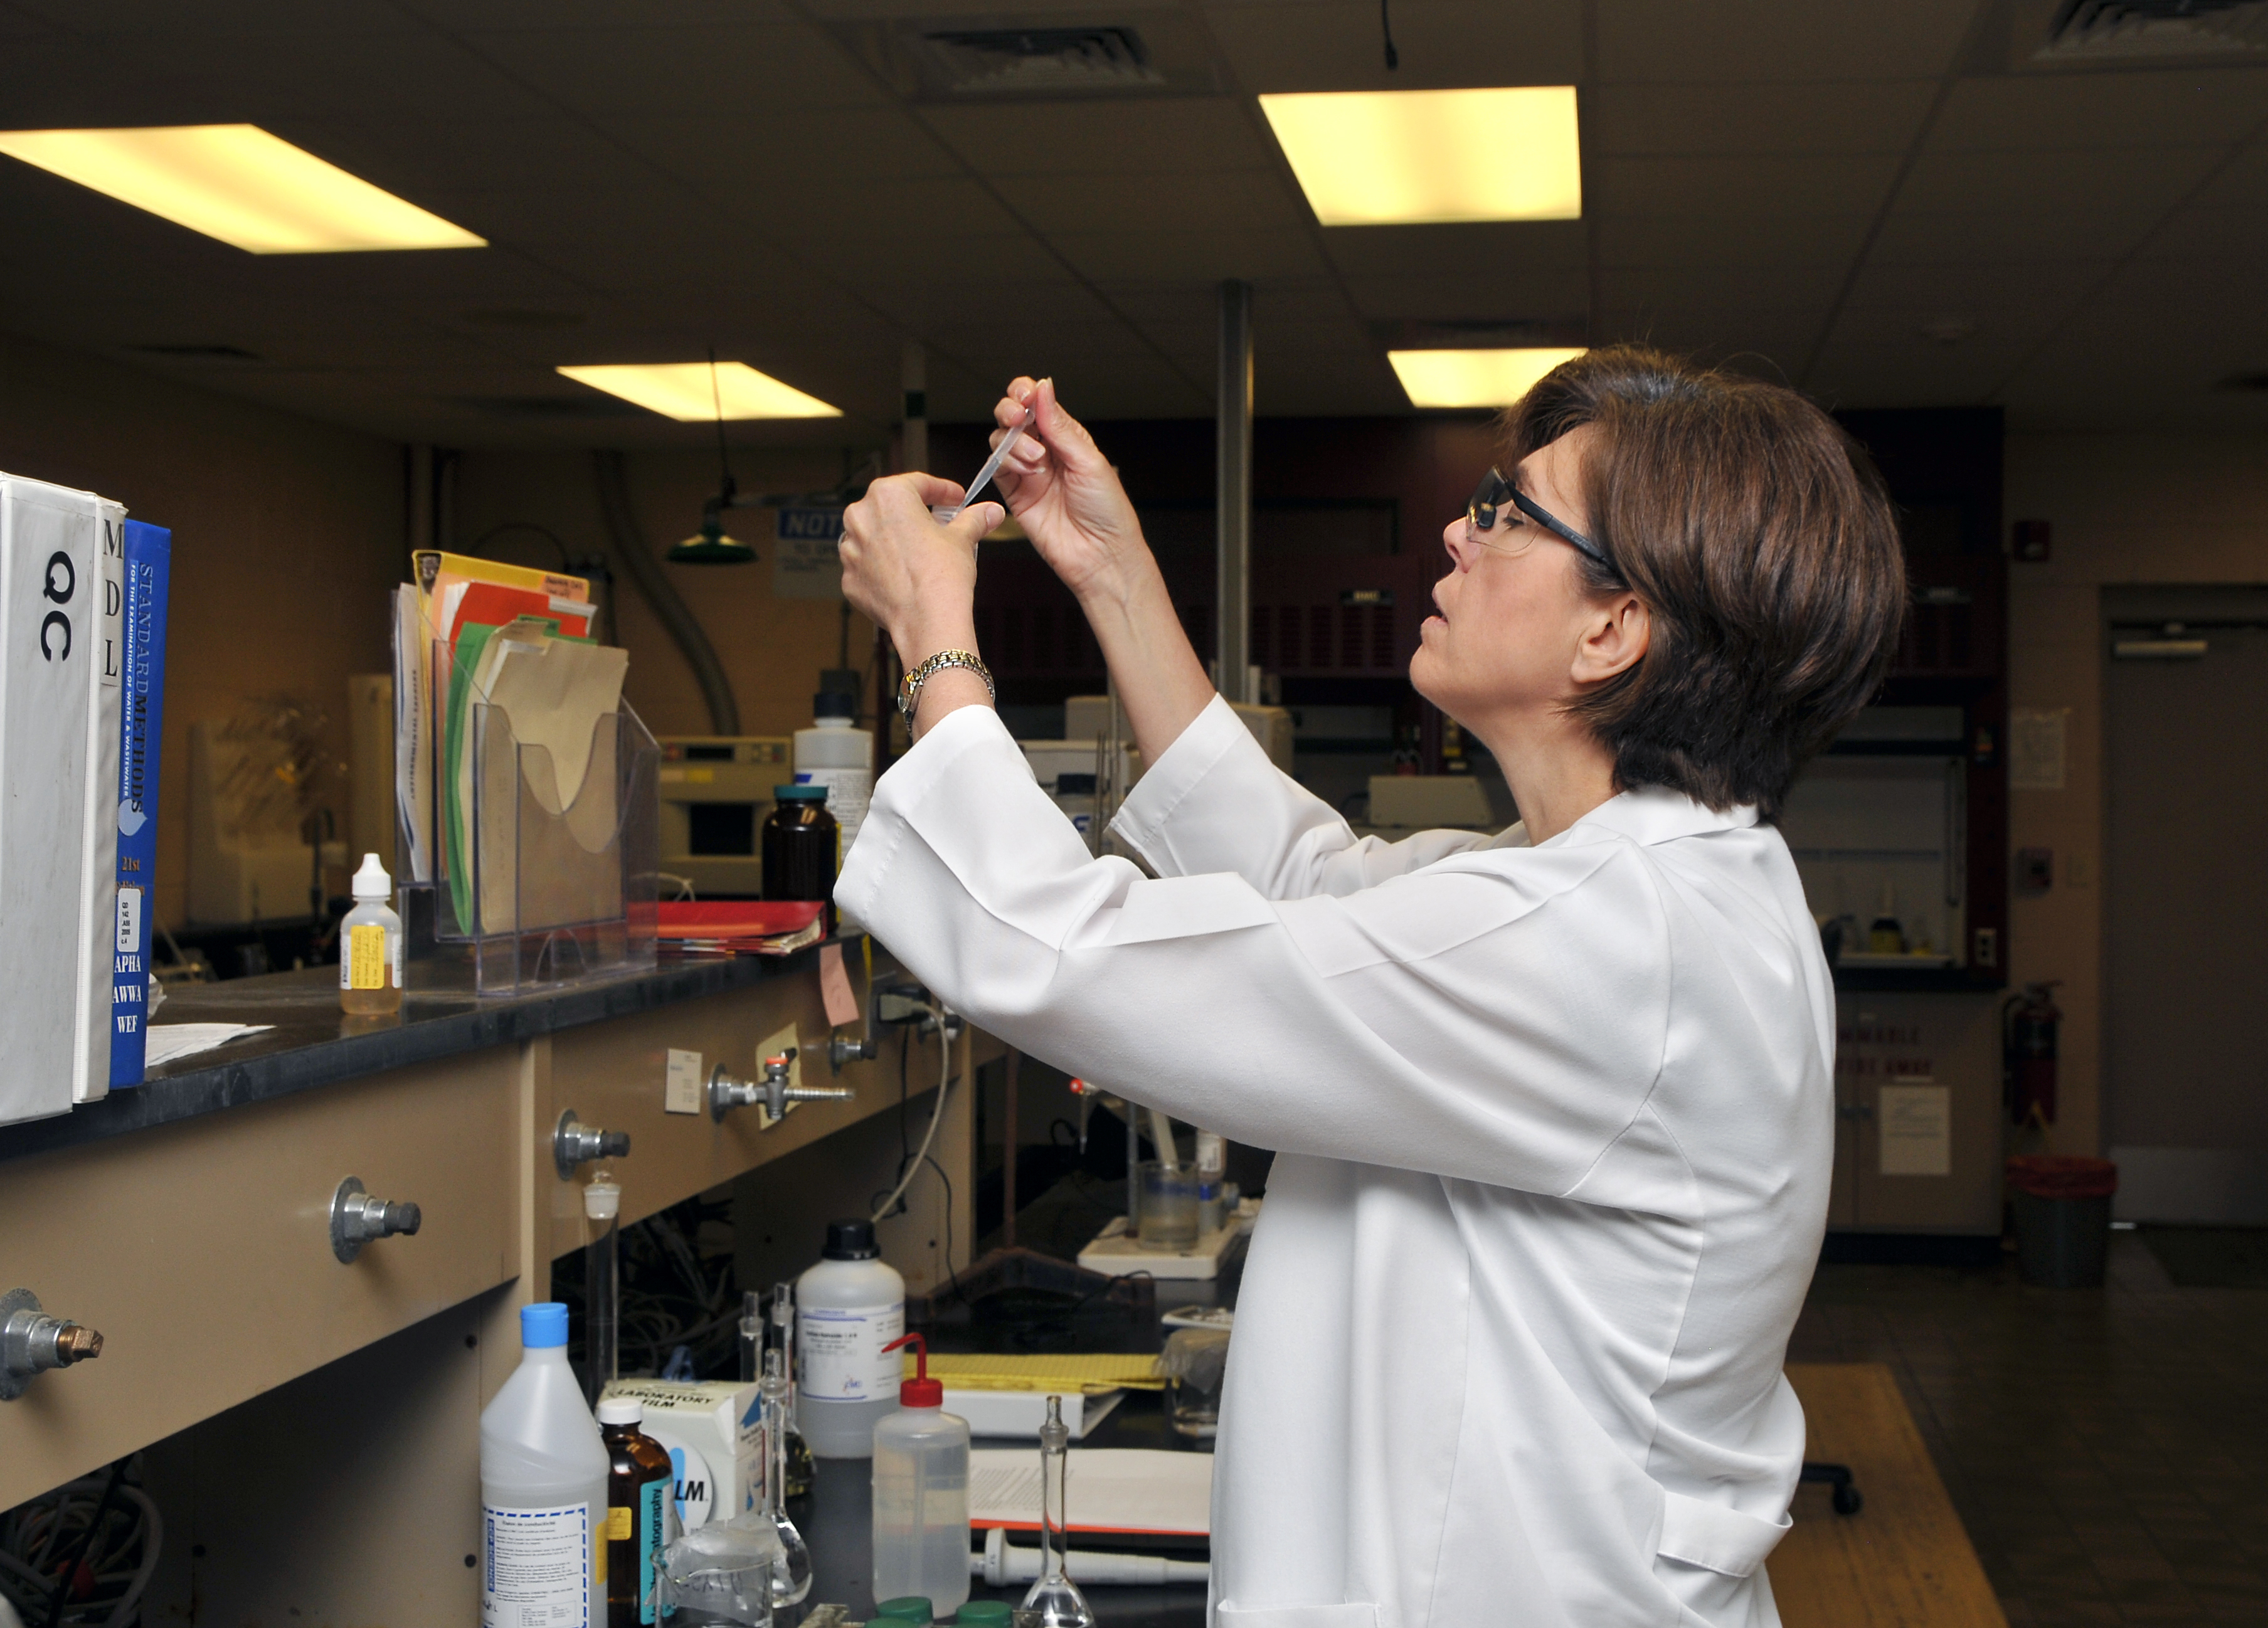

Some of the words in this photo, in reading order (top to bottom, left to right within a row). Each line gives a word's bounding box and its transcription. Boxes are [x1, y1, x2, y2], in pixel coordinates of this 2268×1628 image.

[787, 513, 842, 536] NOT
[41, 551, 75, 662] QC
[136, 562, 153, 693] STANDARD
[127, 675, 132, 687] OF
[131, 695, 147, 813] METHODS
[122, 856, 140, 872] 21st
[114, 955, 141, 973] APHA
[112, 985, 142, 1003] AWWA
[117, 1015, 138, 1033] WEF
[617, 1388, 714, 1405] LABORATORY
[642, 1399, 676, 1408] FILM
[674, 1480, 704, 1501] LM
